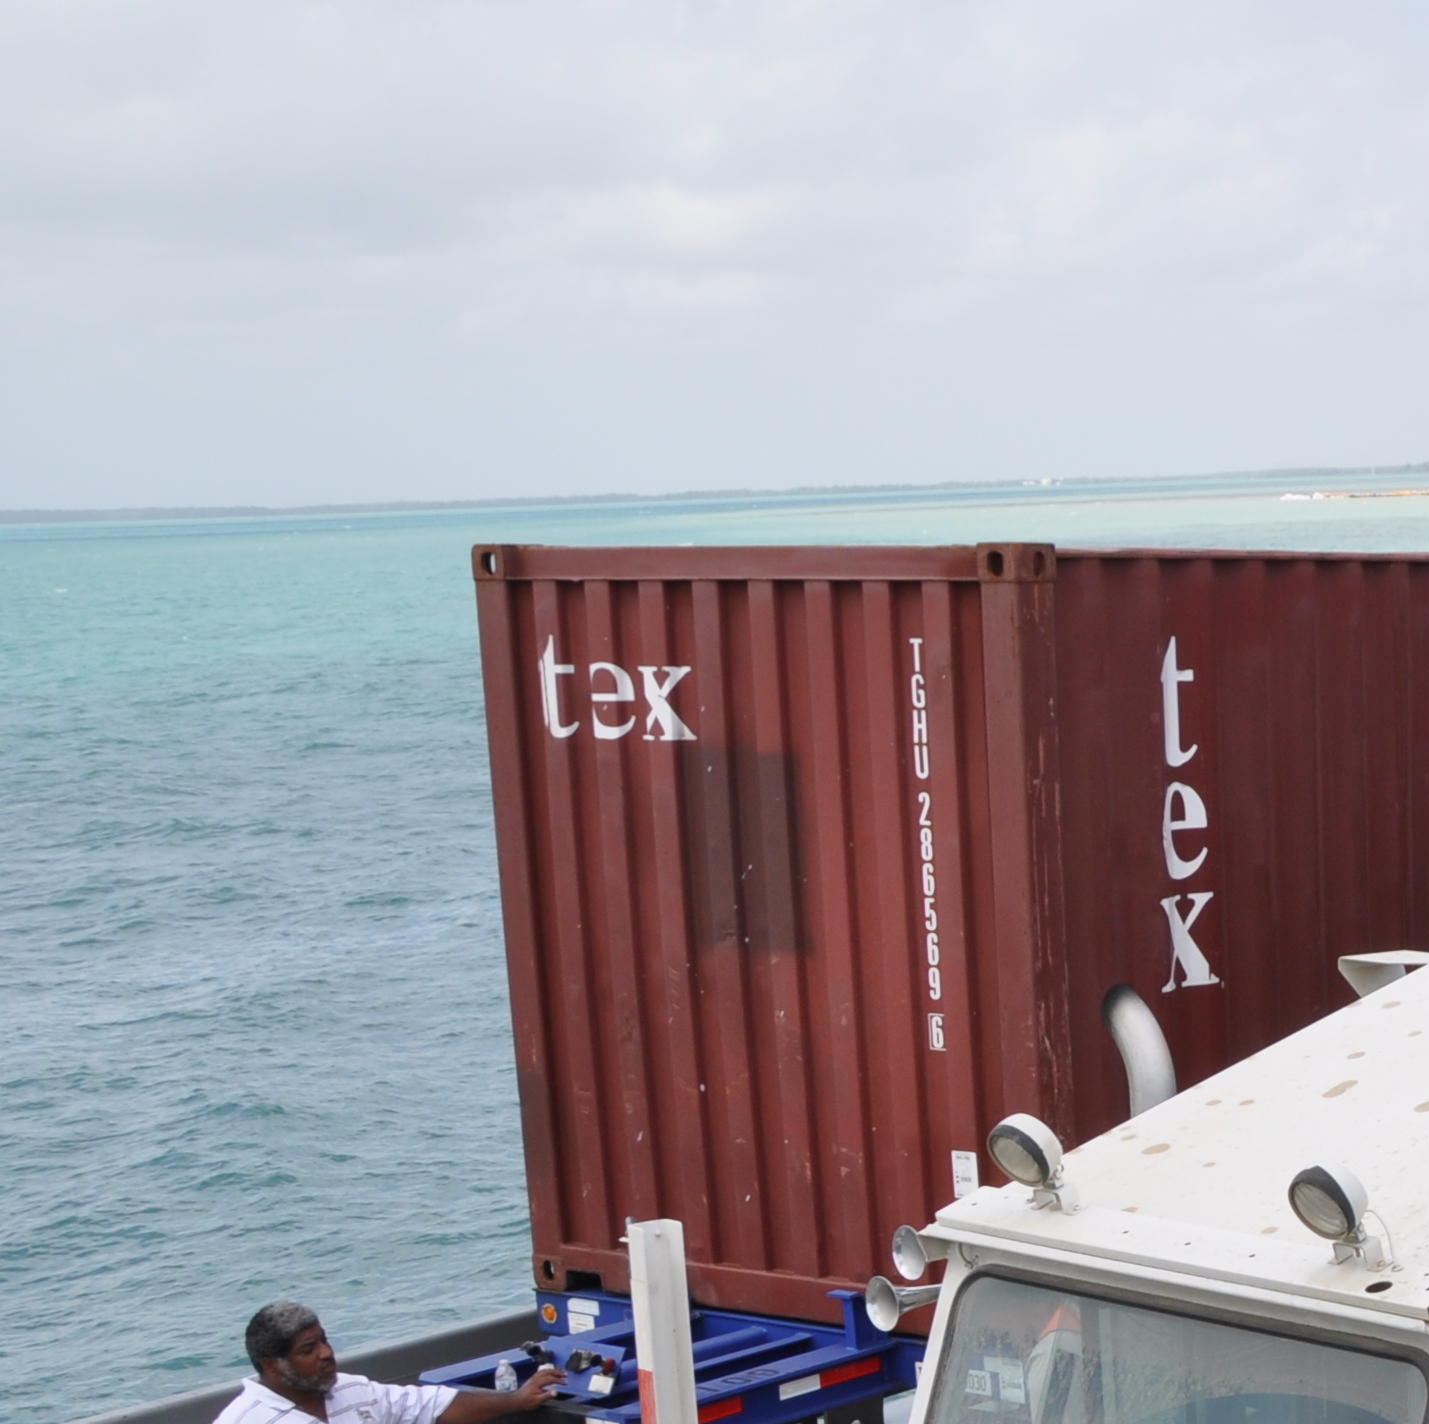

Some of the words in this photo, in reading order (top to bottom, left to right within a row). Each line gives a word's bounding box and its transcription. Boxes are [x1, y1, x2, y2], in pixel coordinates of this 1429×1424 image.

[537, 634, 698, 742] tex
[908, 637, 930, 780] TGHU
[1159, 635, 1221, 993] tex
[916, 792, 942, 1001] 286569
[929, 1013, 946, 1051] 6
